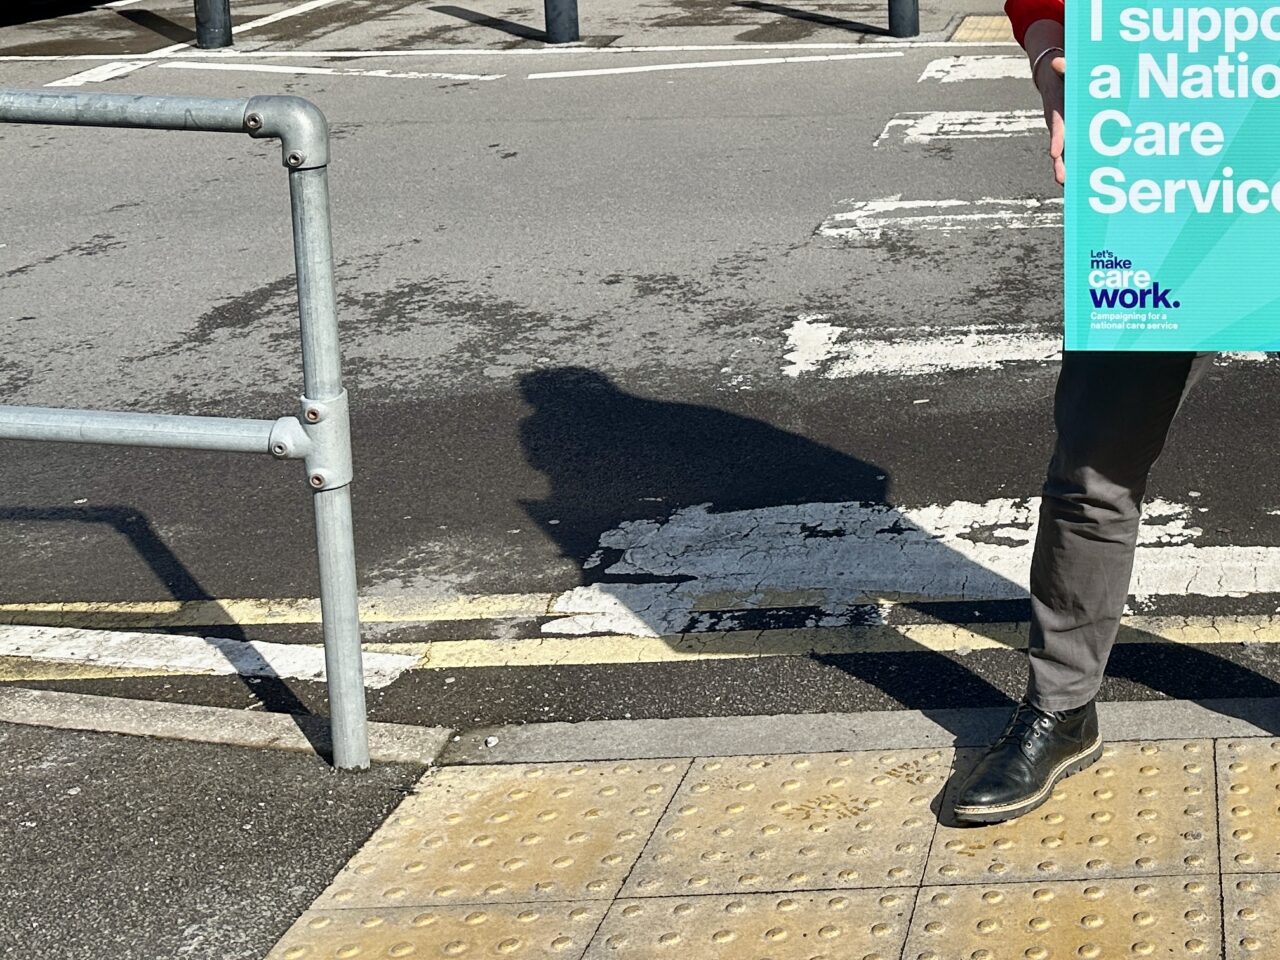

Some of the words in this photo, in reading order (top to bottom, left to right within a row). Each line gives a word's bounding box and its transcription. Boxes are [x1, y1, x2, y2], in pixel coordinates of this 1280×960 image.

[1088, 65, 1121, 100] a
[1088, 109, 1225, 158] Care
[1091, 250, 1113, 258] Let's
[1090, 256, 1132, 269] make
[1088, 270, 1151, 288] care
[1089, 282, 1180, 308] work.
[1090, 312, 1146, 322] Campaigning
[1147, 312, 1160, 320] for
[1090, 322, 1125, 330] national
[1147, 322, 1178, 330] service
